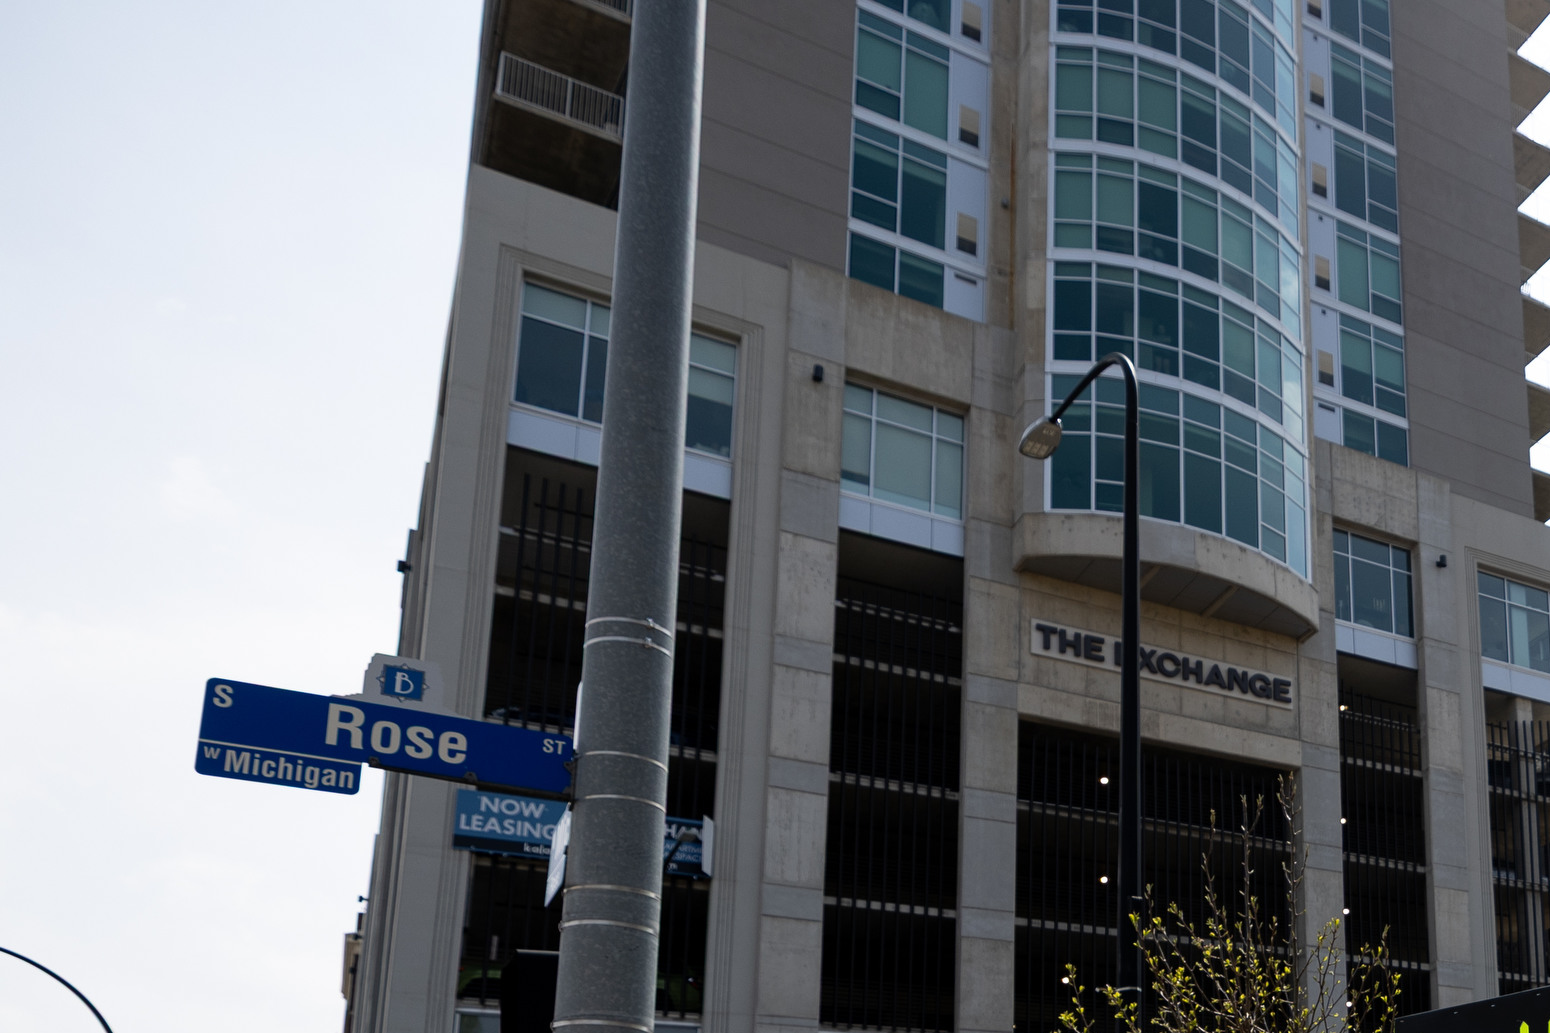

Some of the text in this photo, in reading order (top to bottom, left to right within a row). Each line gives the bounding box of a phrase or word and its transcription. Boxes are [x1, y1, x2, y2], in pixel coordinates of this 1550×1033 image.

[1036, 622, 1105, 662] THE
[213, 684, 566, 765] S Rose ST
[223, 749, 354, 789] Michigan
[479, 796, 545, 819] NOW
